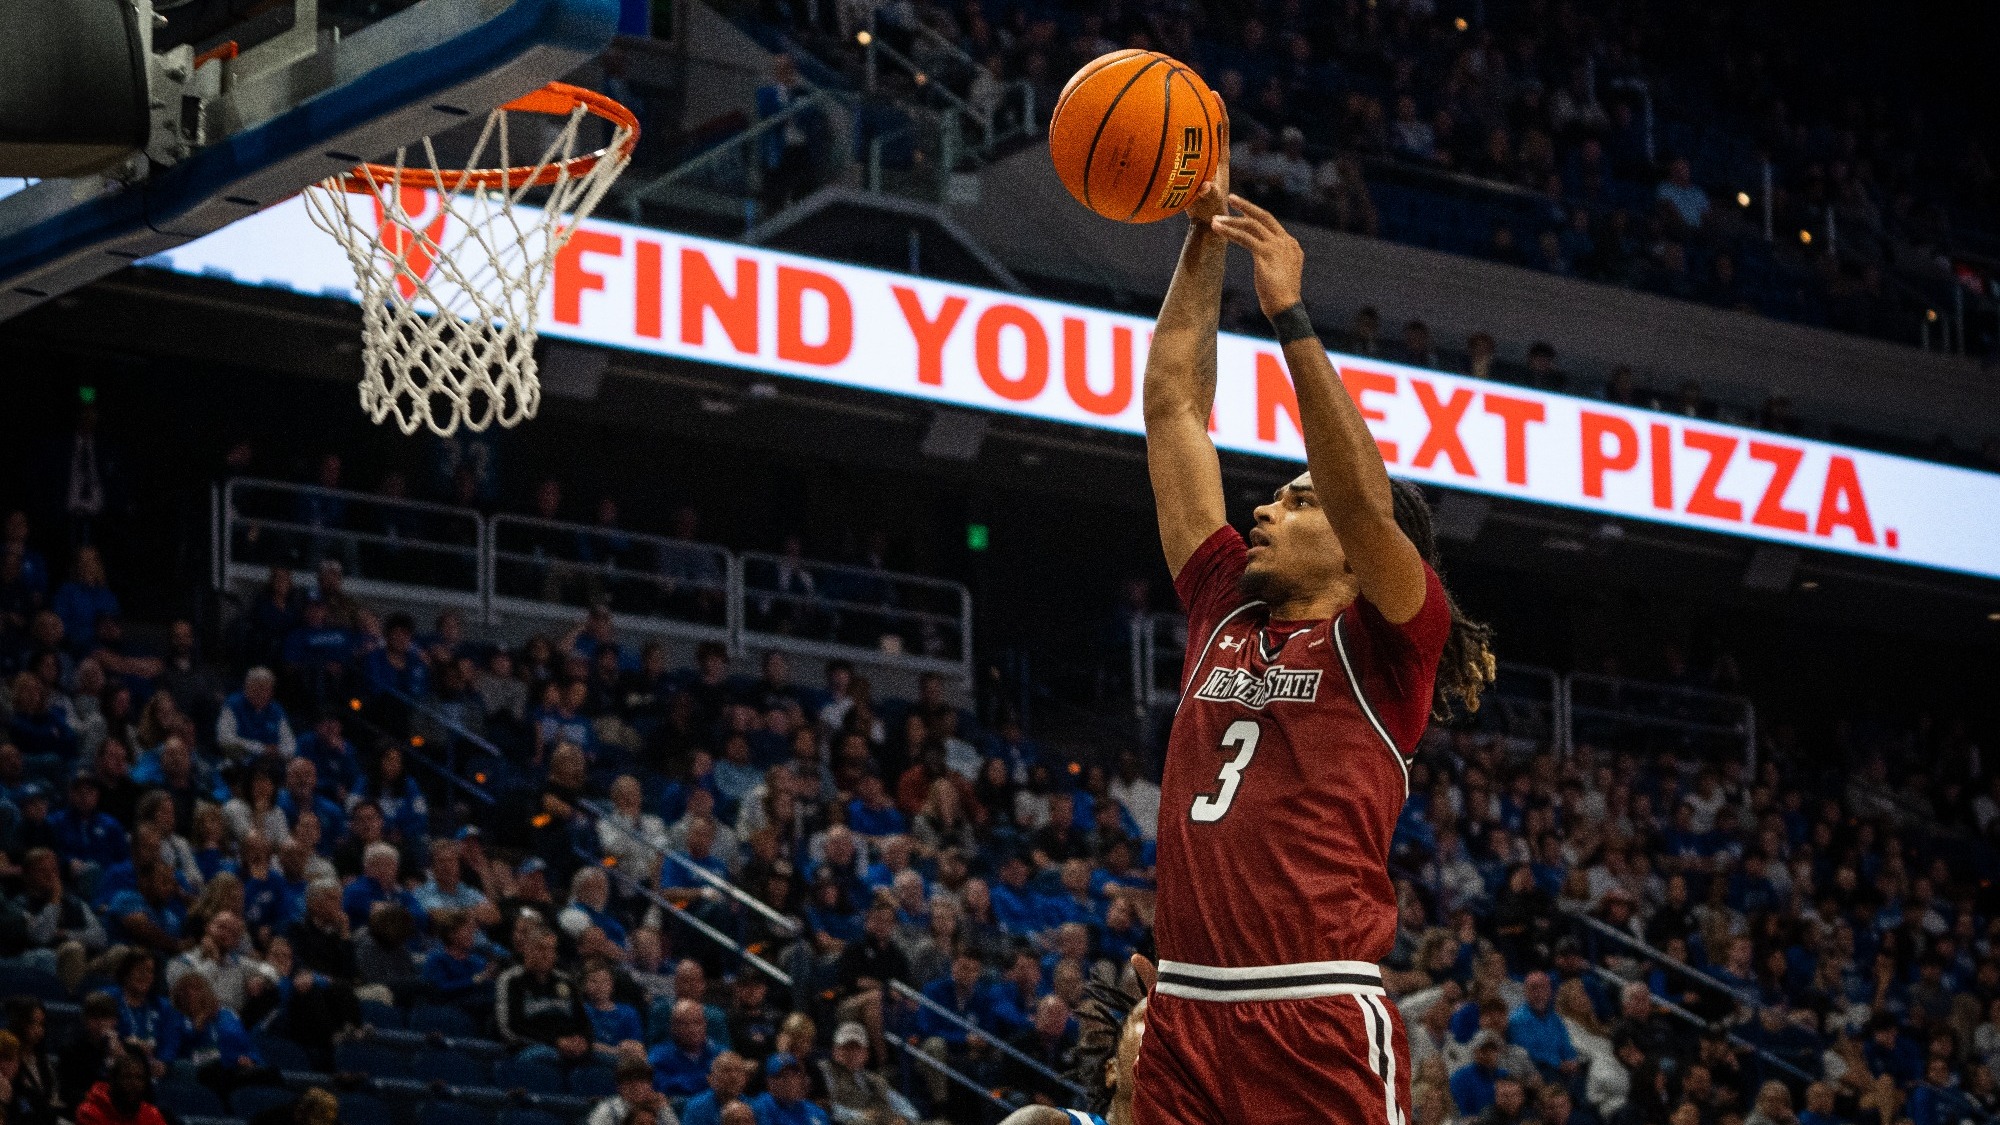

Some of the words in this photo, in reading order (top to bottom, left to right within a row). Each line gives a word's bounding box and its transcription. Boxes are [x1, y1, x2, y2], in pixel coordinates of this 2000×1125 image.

[1156, 138, 1182, 208] AMPIONSHIP
[1161, 127, 1203, 209] ELITE
[552, 226, 854, 367] FIND
[891, 286, 1218, 433] YOU
[1256, 352, 1546, 486] NEXT
[1580, 411, 1899, 550] PIZZA.
[1264, 669, 1316, 699] STATE
[1190, 719, 1260, 823] 3
